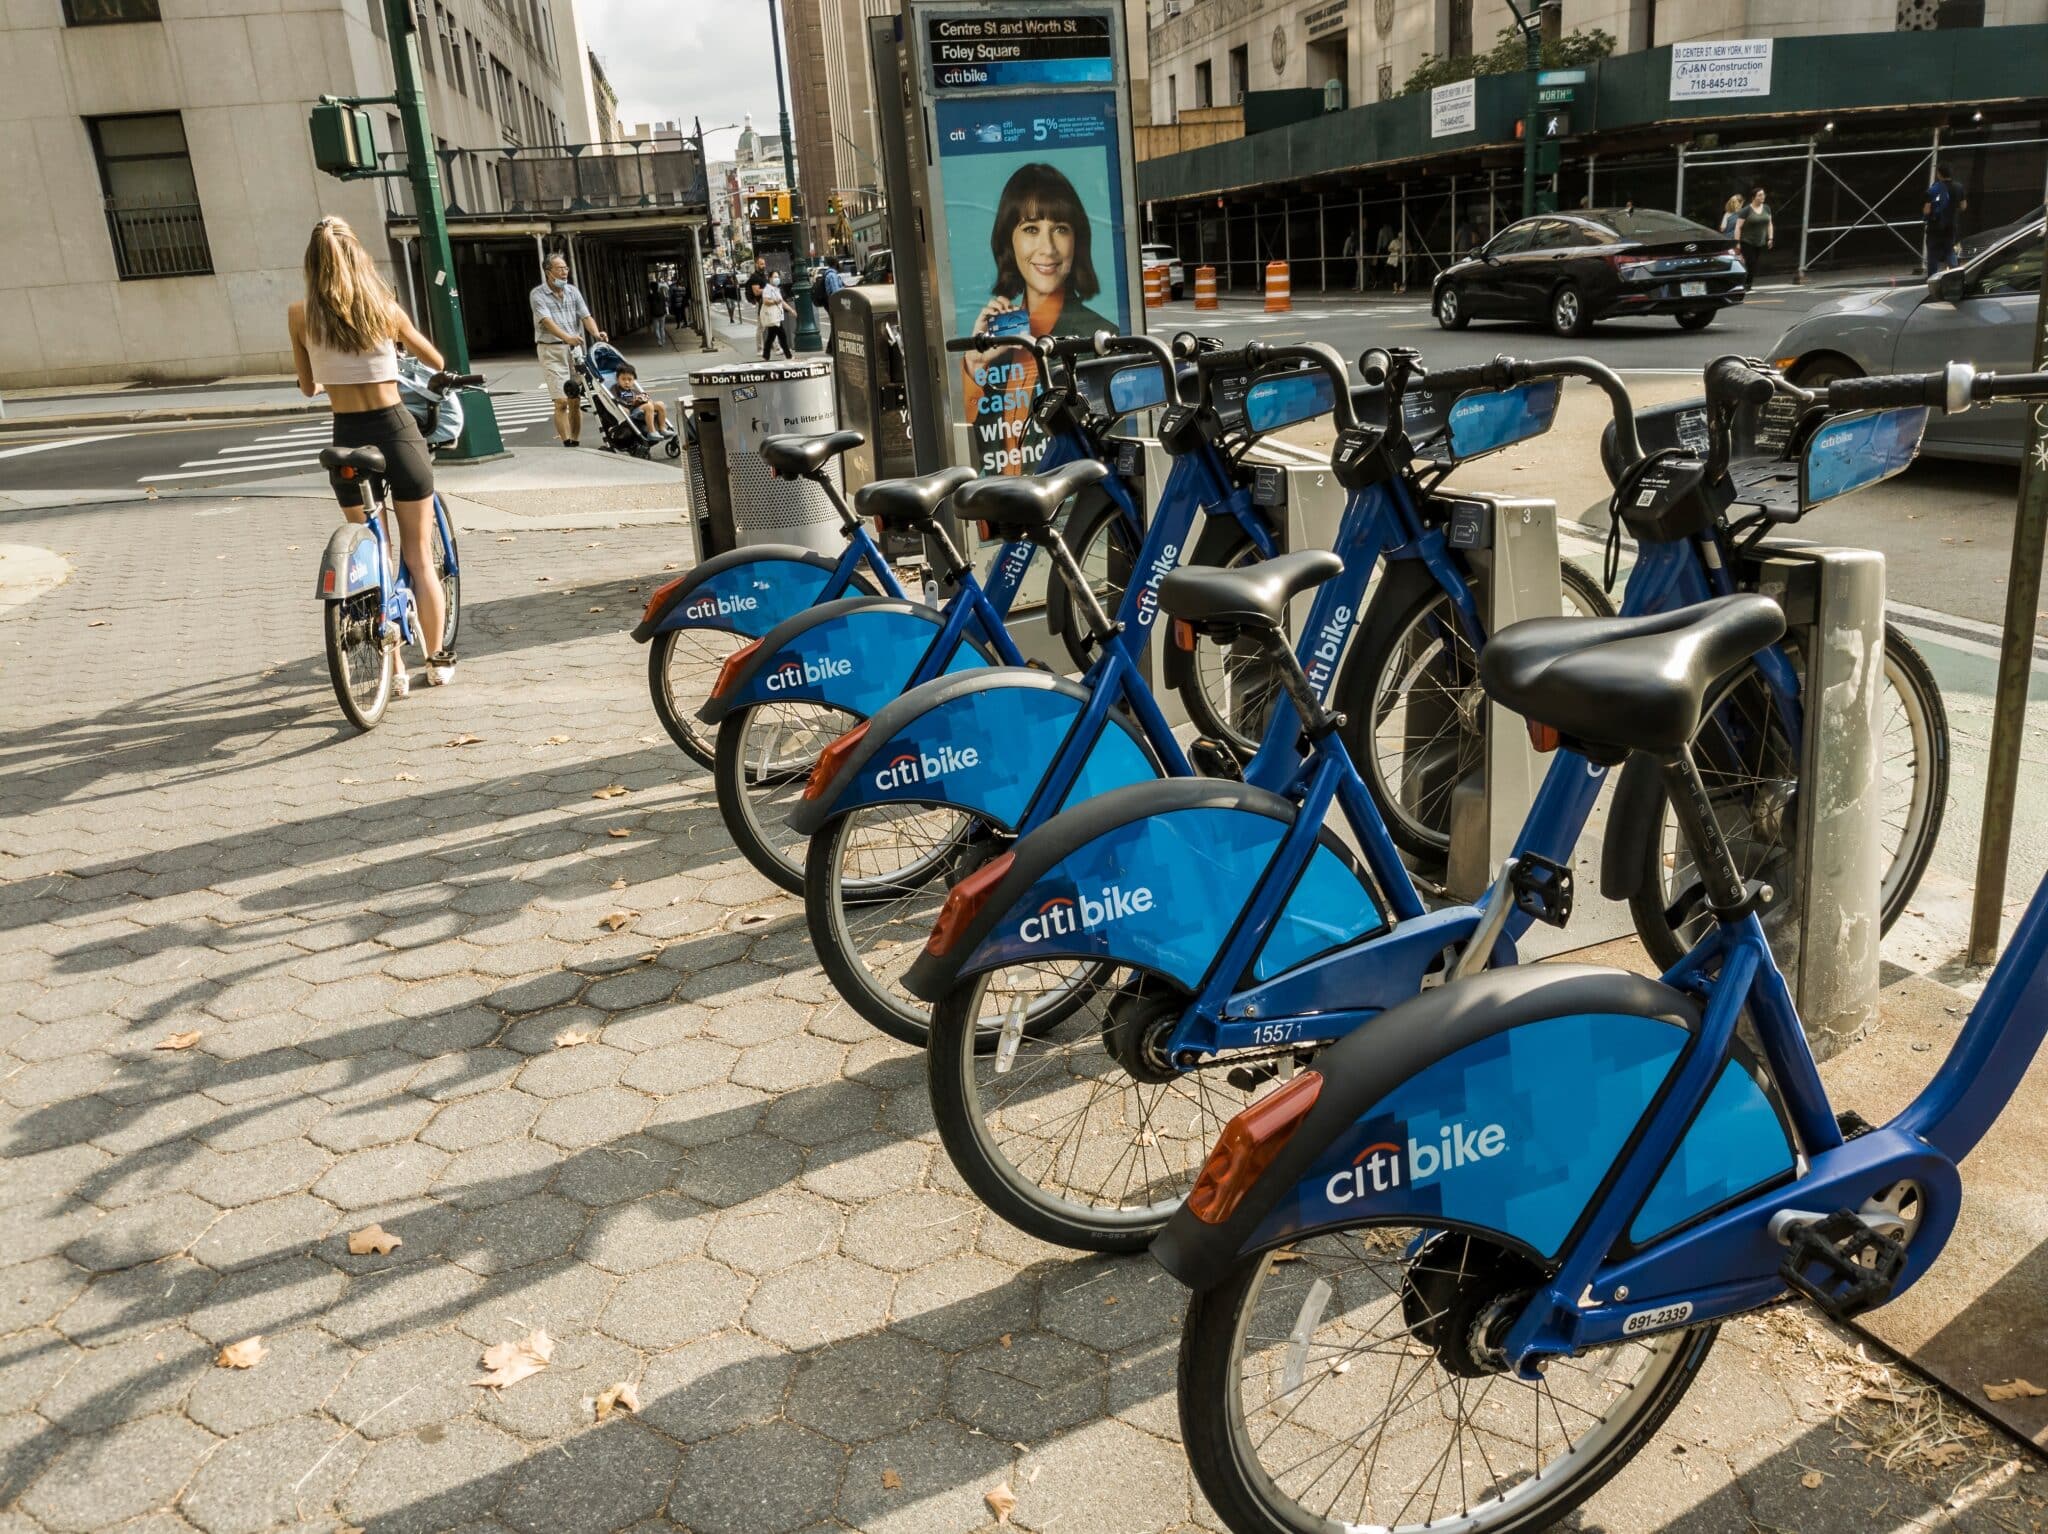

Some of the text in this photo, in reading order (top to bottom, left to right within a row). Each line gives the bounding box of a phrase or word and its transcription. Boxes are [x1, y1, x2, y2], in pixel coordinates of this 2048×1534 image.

[940, 19, 1077, 36] Centre St and Worth St
[942, 44, 1020, 61] Foley Square
[1682, 47, 1704, 58] CENTER
[1714, 46, 1726, 56] NEW
[1744, 44, 1752, 54] NY
[1688, 61, 1763, 73] J&N Construction
[1690, 77, 1748, 90] 718-845-0123
[1540, 89, 1566, 101] WORTH
[950, 129, 966, 141] citi
[712, 375, 736, 384] Don't
[783, 369, 808, 379] Don't
[974, 362, 1025, 386] earn
[977, 387, 1029, 414] cash
[784, 417, 799, 426] Put
[800, 415, 817, 424] litter
[983, 437, 1047, 474] spend
[1316, 473, 1324, 487] 2
[1523, 507, 1531, 524] 3
[1628, 1306, 1688, 1331] 891-2339
